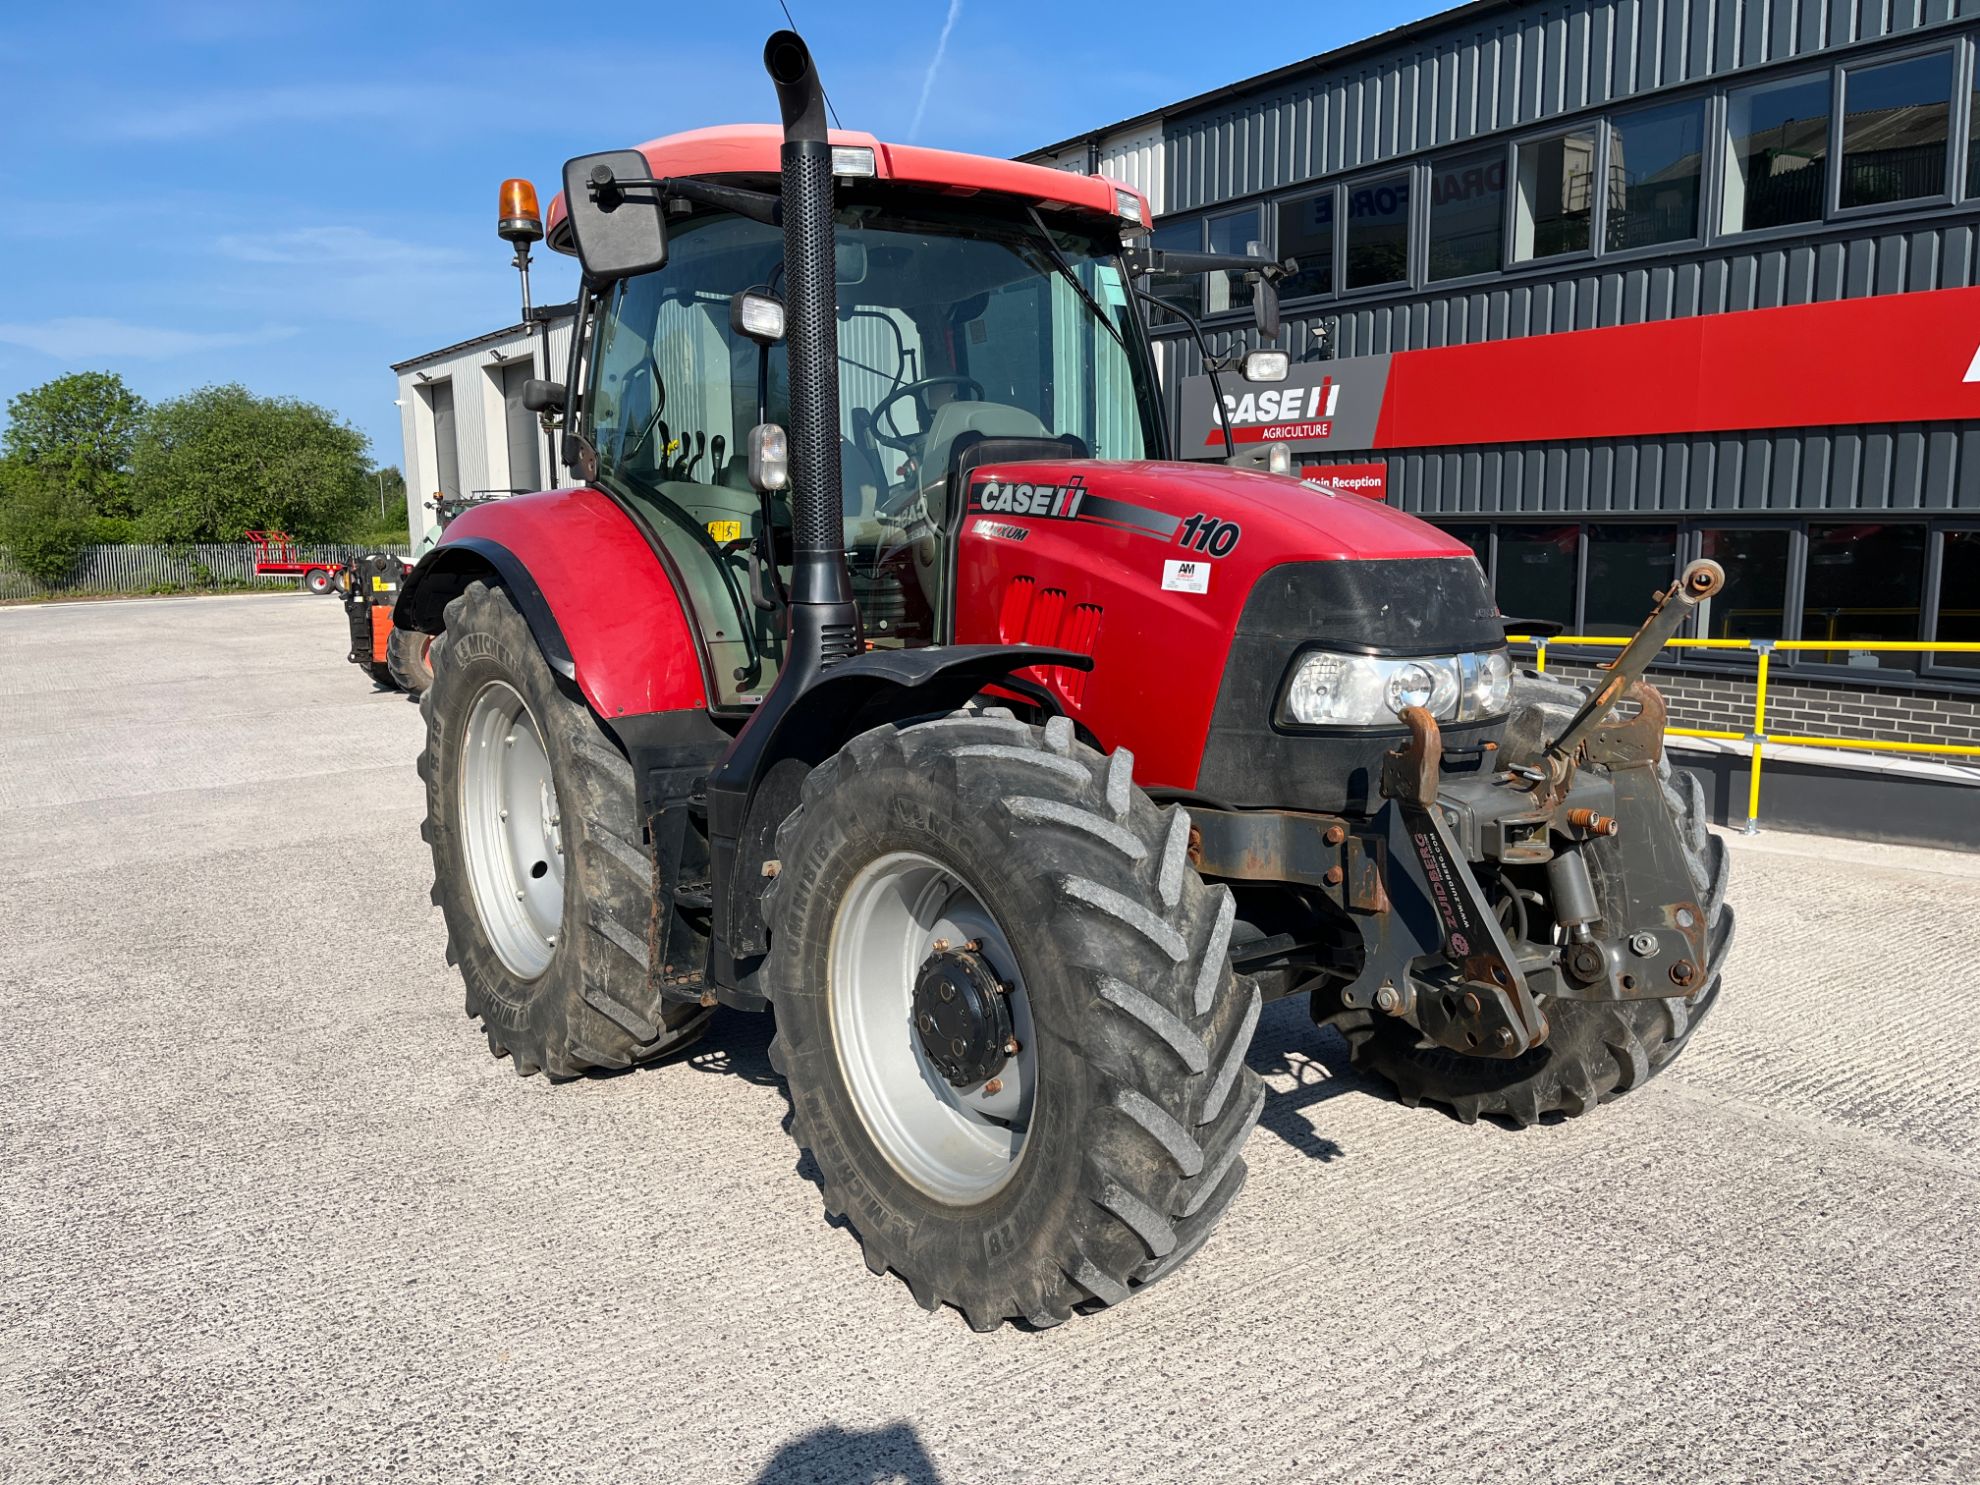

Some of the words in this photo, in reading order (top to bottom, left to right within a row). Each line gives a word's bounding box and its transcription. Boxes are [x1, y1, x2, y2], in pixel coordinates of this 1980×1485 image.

[1213, 388, 1304, 425] CASE
[1262, 424, 1328, 439] AGRICULTURE
[980, 481, 1052, 516] CASE
[1332, 476, 1382, 490] Reception
[1179, 512, 1241, 558] 110
[1178, 563, 1195, 574] AM
[1414, 833, 1458, 928] ZUIDBERG
[1429, 832, 1470, 928] WWW.ZUIDBERG.COM
